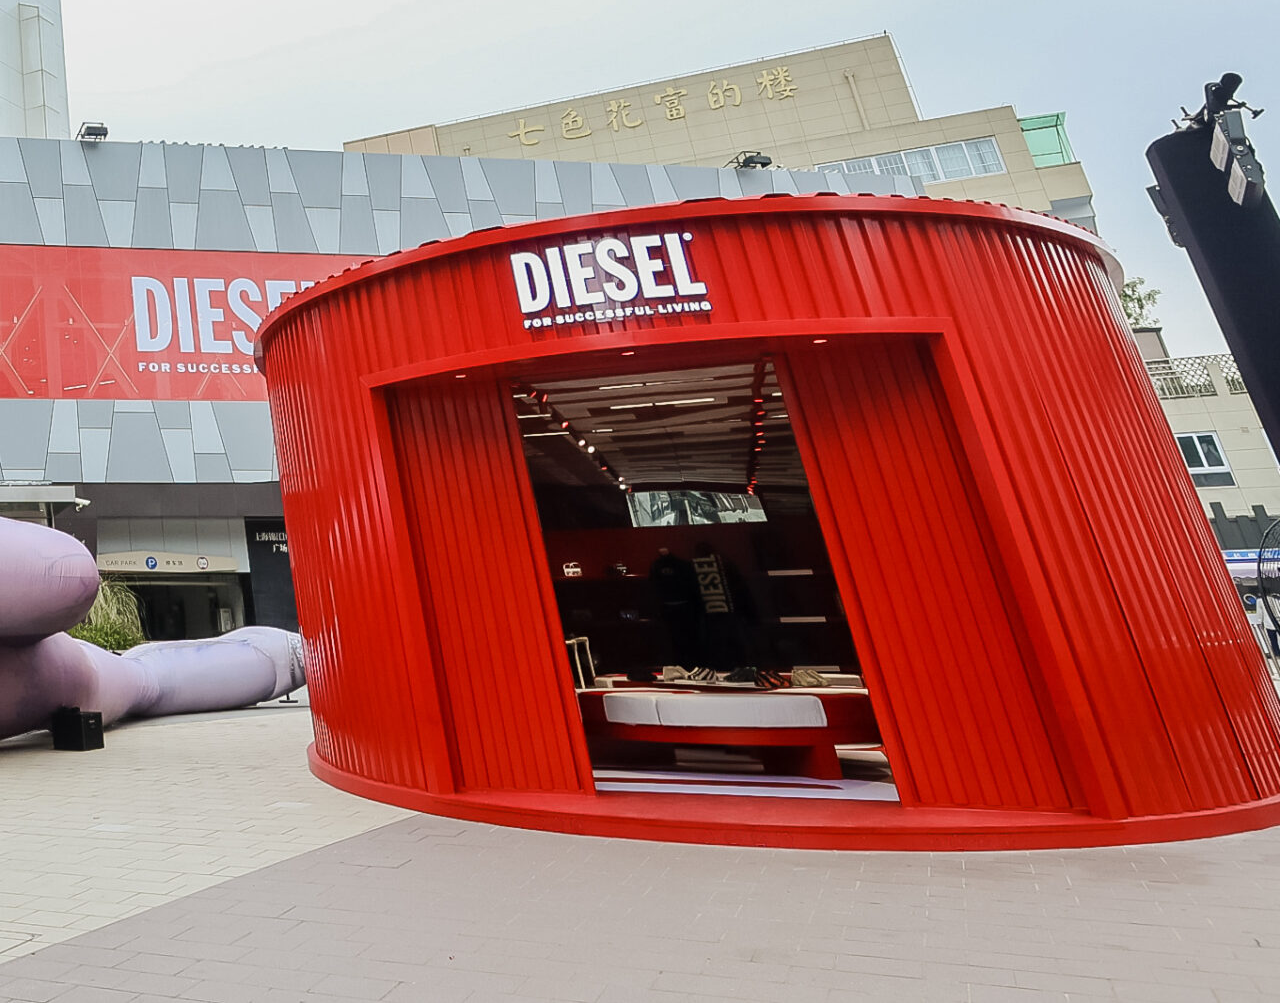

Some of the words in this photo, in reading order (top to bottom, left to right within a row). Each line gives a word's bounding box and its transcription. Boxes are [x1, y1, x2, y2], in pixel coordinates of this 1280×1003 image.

[508, 66, 799, 146] 七色花富的楼
[510, 232, 708, 314] DIESEL
[131, 276, 315, 356] DIES
[523, 317, 553, 330] FOR
[554, 305, 656, 324] SUCCESSFUL
[657, 301, 712, 314] LIVING
[138, 362, 171, 372] FOR
[692, 553, 729, 614] DIESEL
